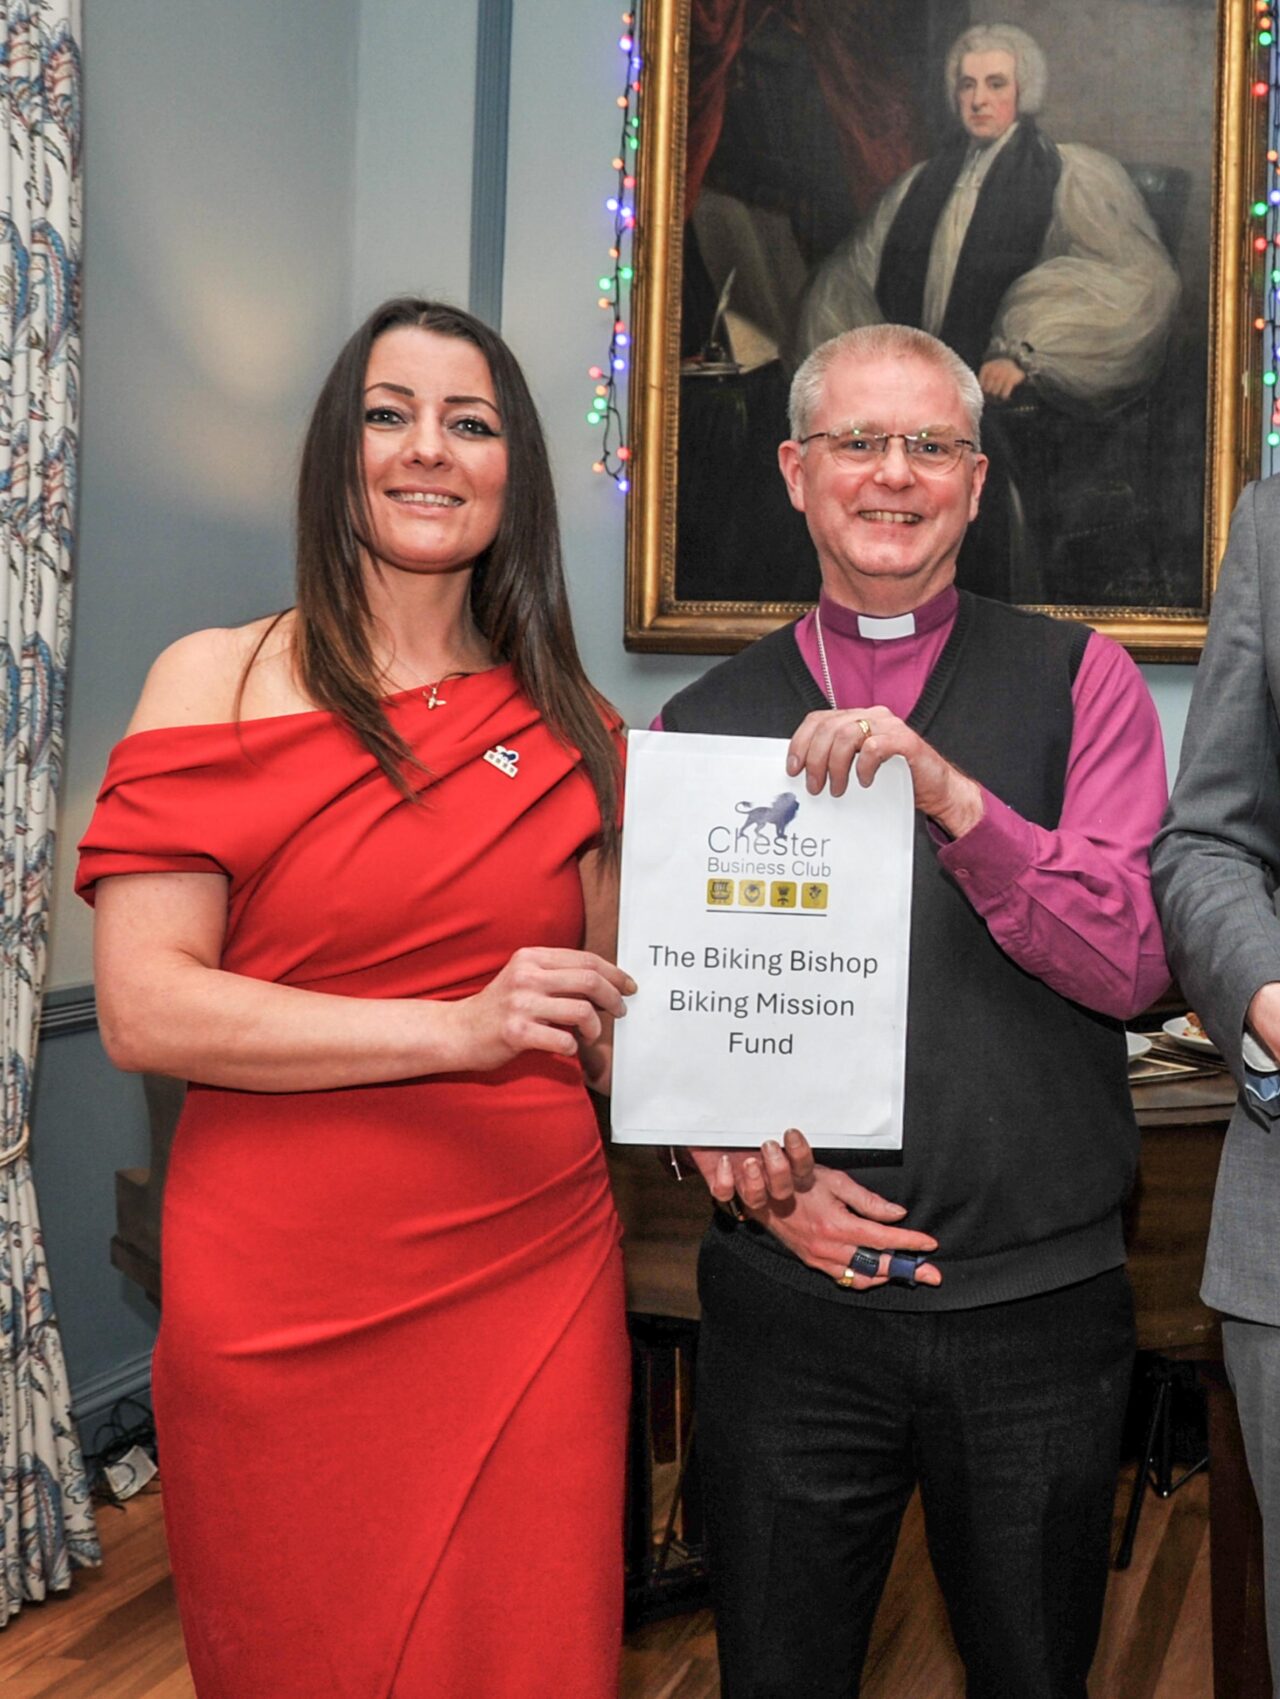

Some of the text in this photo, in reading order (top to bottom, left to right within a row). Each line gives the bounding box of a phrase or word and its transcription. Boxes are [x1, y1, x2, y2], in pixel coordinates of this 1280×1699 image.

[708, 825, 831, 858] Chester
[708, 857, 831, 878] Business Club
[649, 945, 879, 979] The Biking Bishop
[670, 990, 855, 1019] Biking Mission
[729, 1032, 794, 1055] Fund
